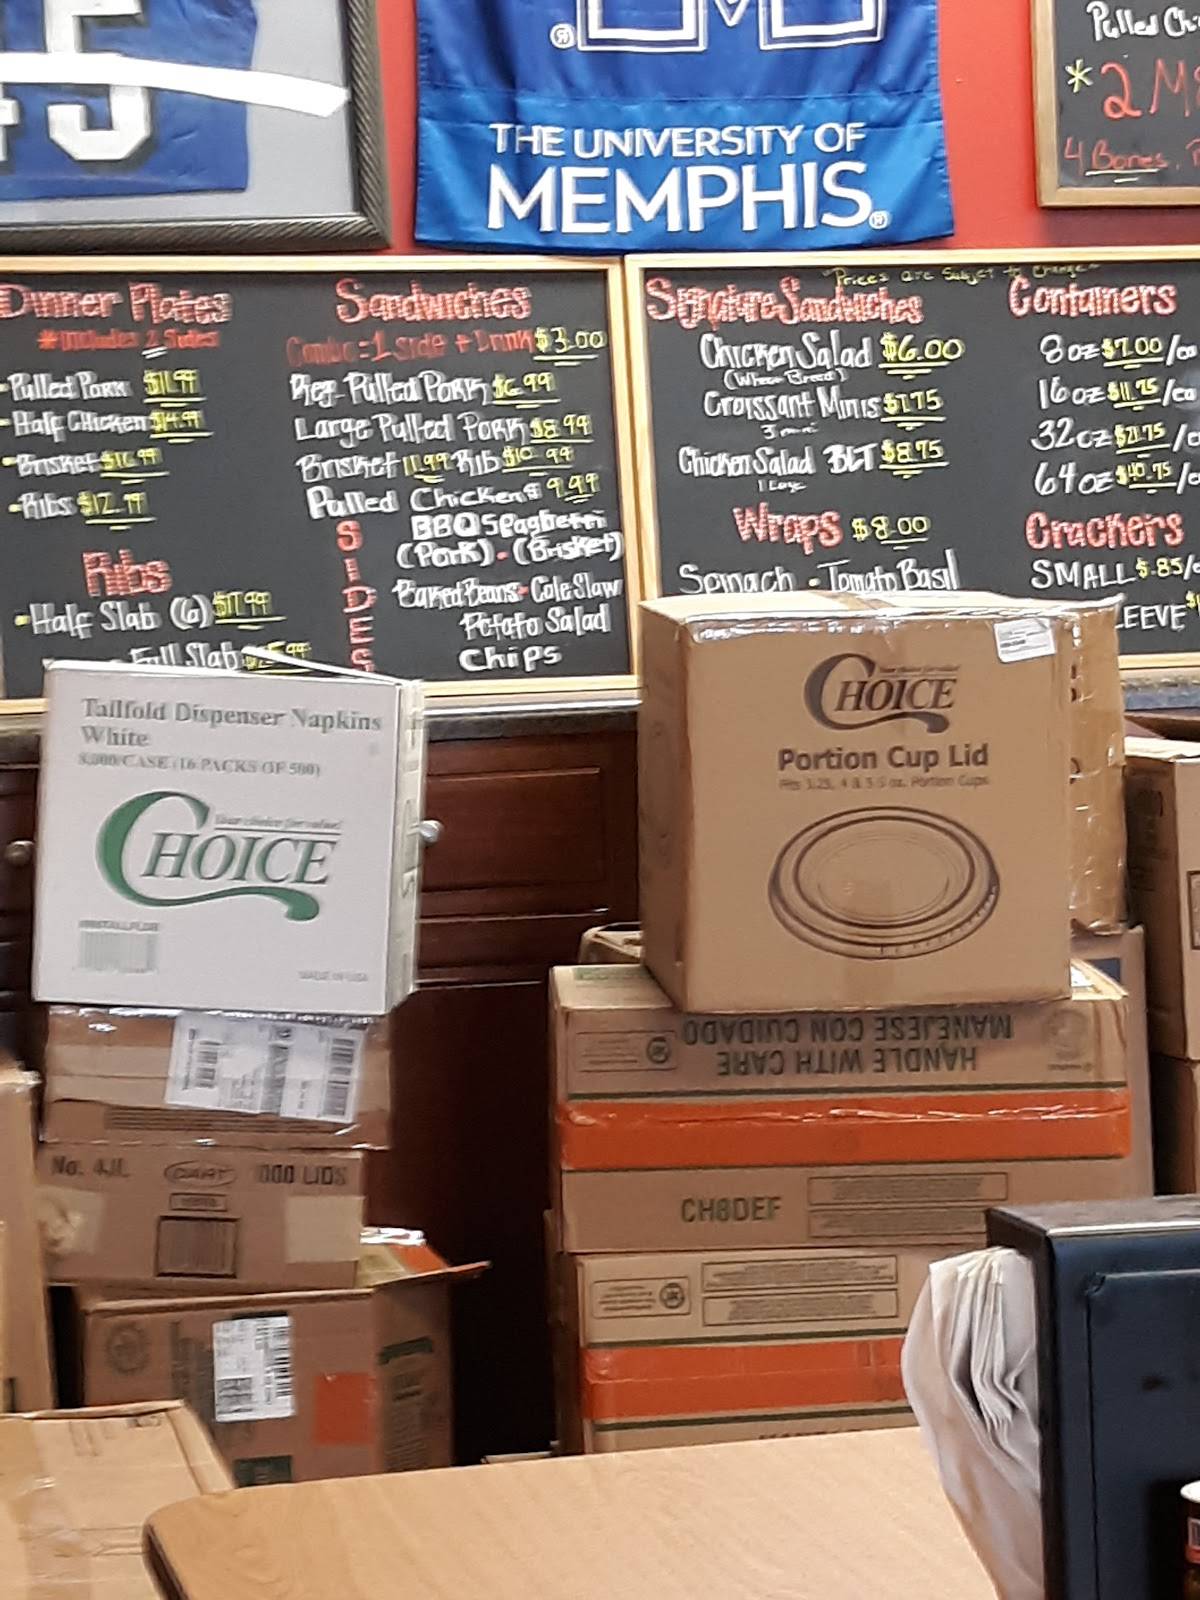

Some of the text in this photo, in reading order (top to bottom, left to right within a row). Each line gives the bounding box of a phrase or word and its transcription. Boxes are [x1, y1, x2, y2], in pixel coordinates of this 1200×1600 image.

[1086, 1, 1159, 41] Pulled
[1100, 61, 1143, 118] 2
[489, 122, 866, 159] THE UNIVERSITY OF
[335, 278, 532, 324] Sandwiches
[796, 330, 872, 369] Salad
[880, 332, 965, 362] $6.00
[703, 390, 816, 421] Croissant
[294, 416, 374, 449] Large
[372, 412, 454, 443] Pulled
[305, 485, 399, 520] Pulled
[733, 502, 844, 555] Wraps
[1025, 511, 1186, 550] Crackers
[82, 549, 173, 597] Ribs
[1031, 560, 1137, 589] SMALL
[29, 602, 93, 640] Half
[100, 600, 161, 632] Slab
[458, 645, 563, 673] Chips
[803, 652, 957, 735] CHOICE
[81, 725, 150, 748] White
[173, 704, 285, 728] Dispenser
[292, 708, 383, 732] Napkins
[778, 743, 990, 773] Portion Cup Lid
[96, 791, 340, 922] CHOICE
[683, 1013, 1015, 1046] MANEJESE CON CUIDADO
[717, 1046, 978, 1077] HANDLE WITH CARE
